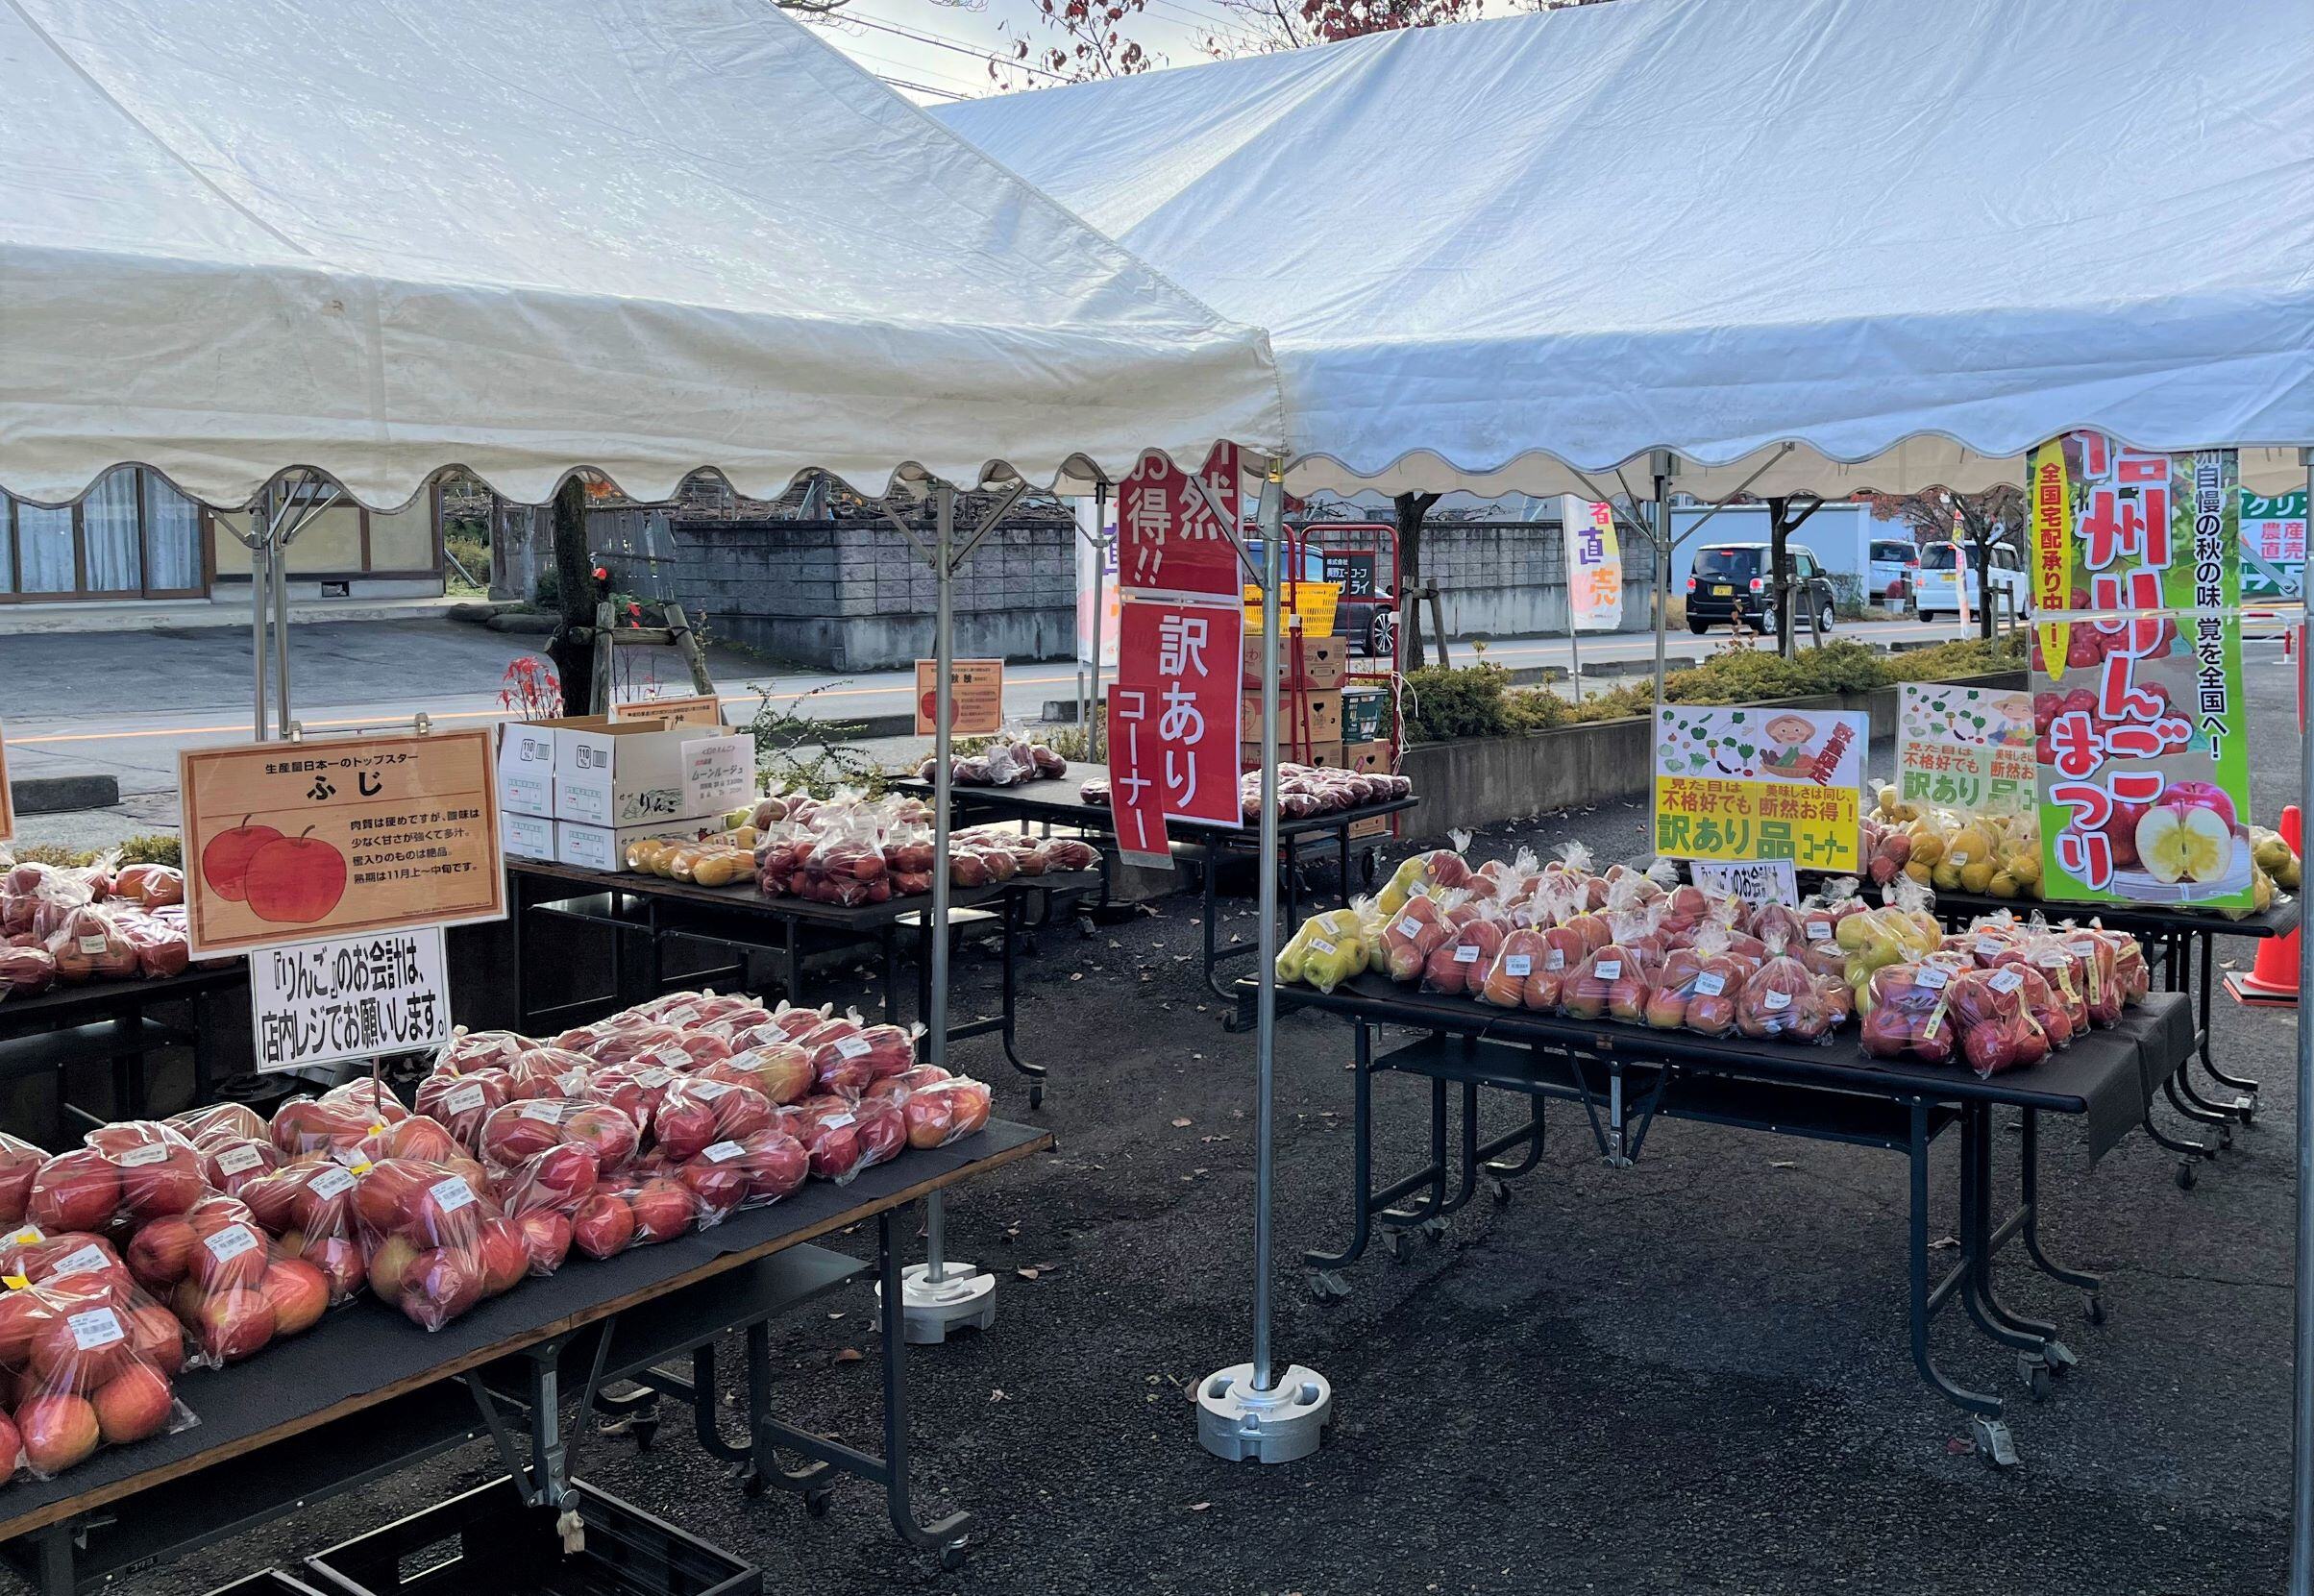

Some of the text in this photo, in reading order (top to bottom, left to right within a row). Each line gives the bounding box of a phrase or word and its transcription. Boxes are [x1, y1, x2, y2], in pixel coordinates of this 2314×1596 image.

[1158, 615, 1209, 808] 訳あり
[578, 748, 590, 759] 110
[1908, 742, 1973, 756] 見た目は
[265, 753, 418, 774] 生産量日本一のトップスター
[1119, 690, 1152, 849] コーナー
[1903, 752, 1980, 773] 不格好でも
[1670, 778, 1742, 793] 見た目は
[1766, 784, 1851, 801] 美味しさは同じ、
[1662, 790, 1752, 815] 不格好でも
[2051, 712, 2113, 891] まつり
[350, 809, 480, 831] 肉質は硬めですが、酸味は
[351, 827, 470, 848] 少なく甘さが強くて多汁。
[261, 989, 445, 1063] 店内レジでお願いします。
